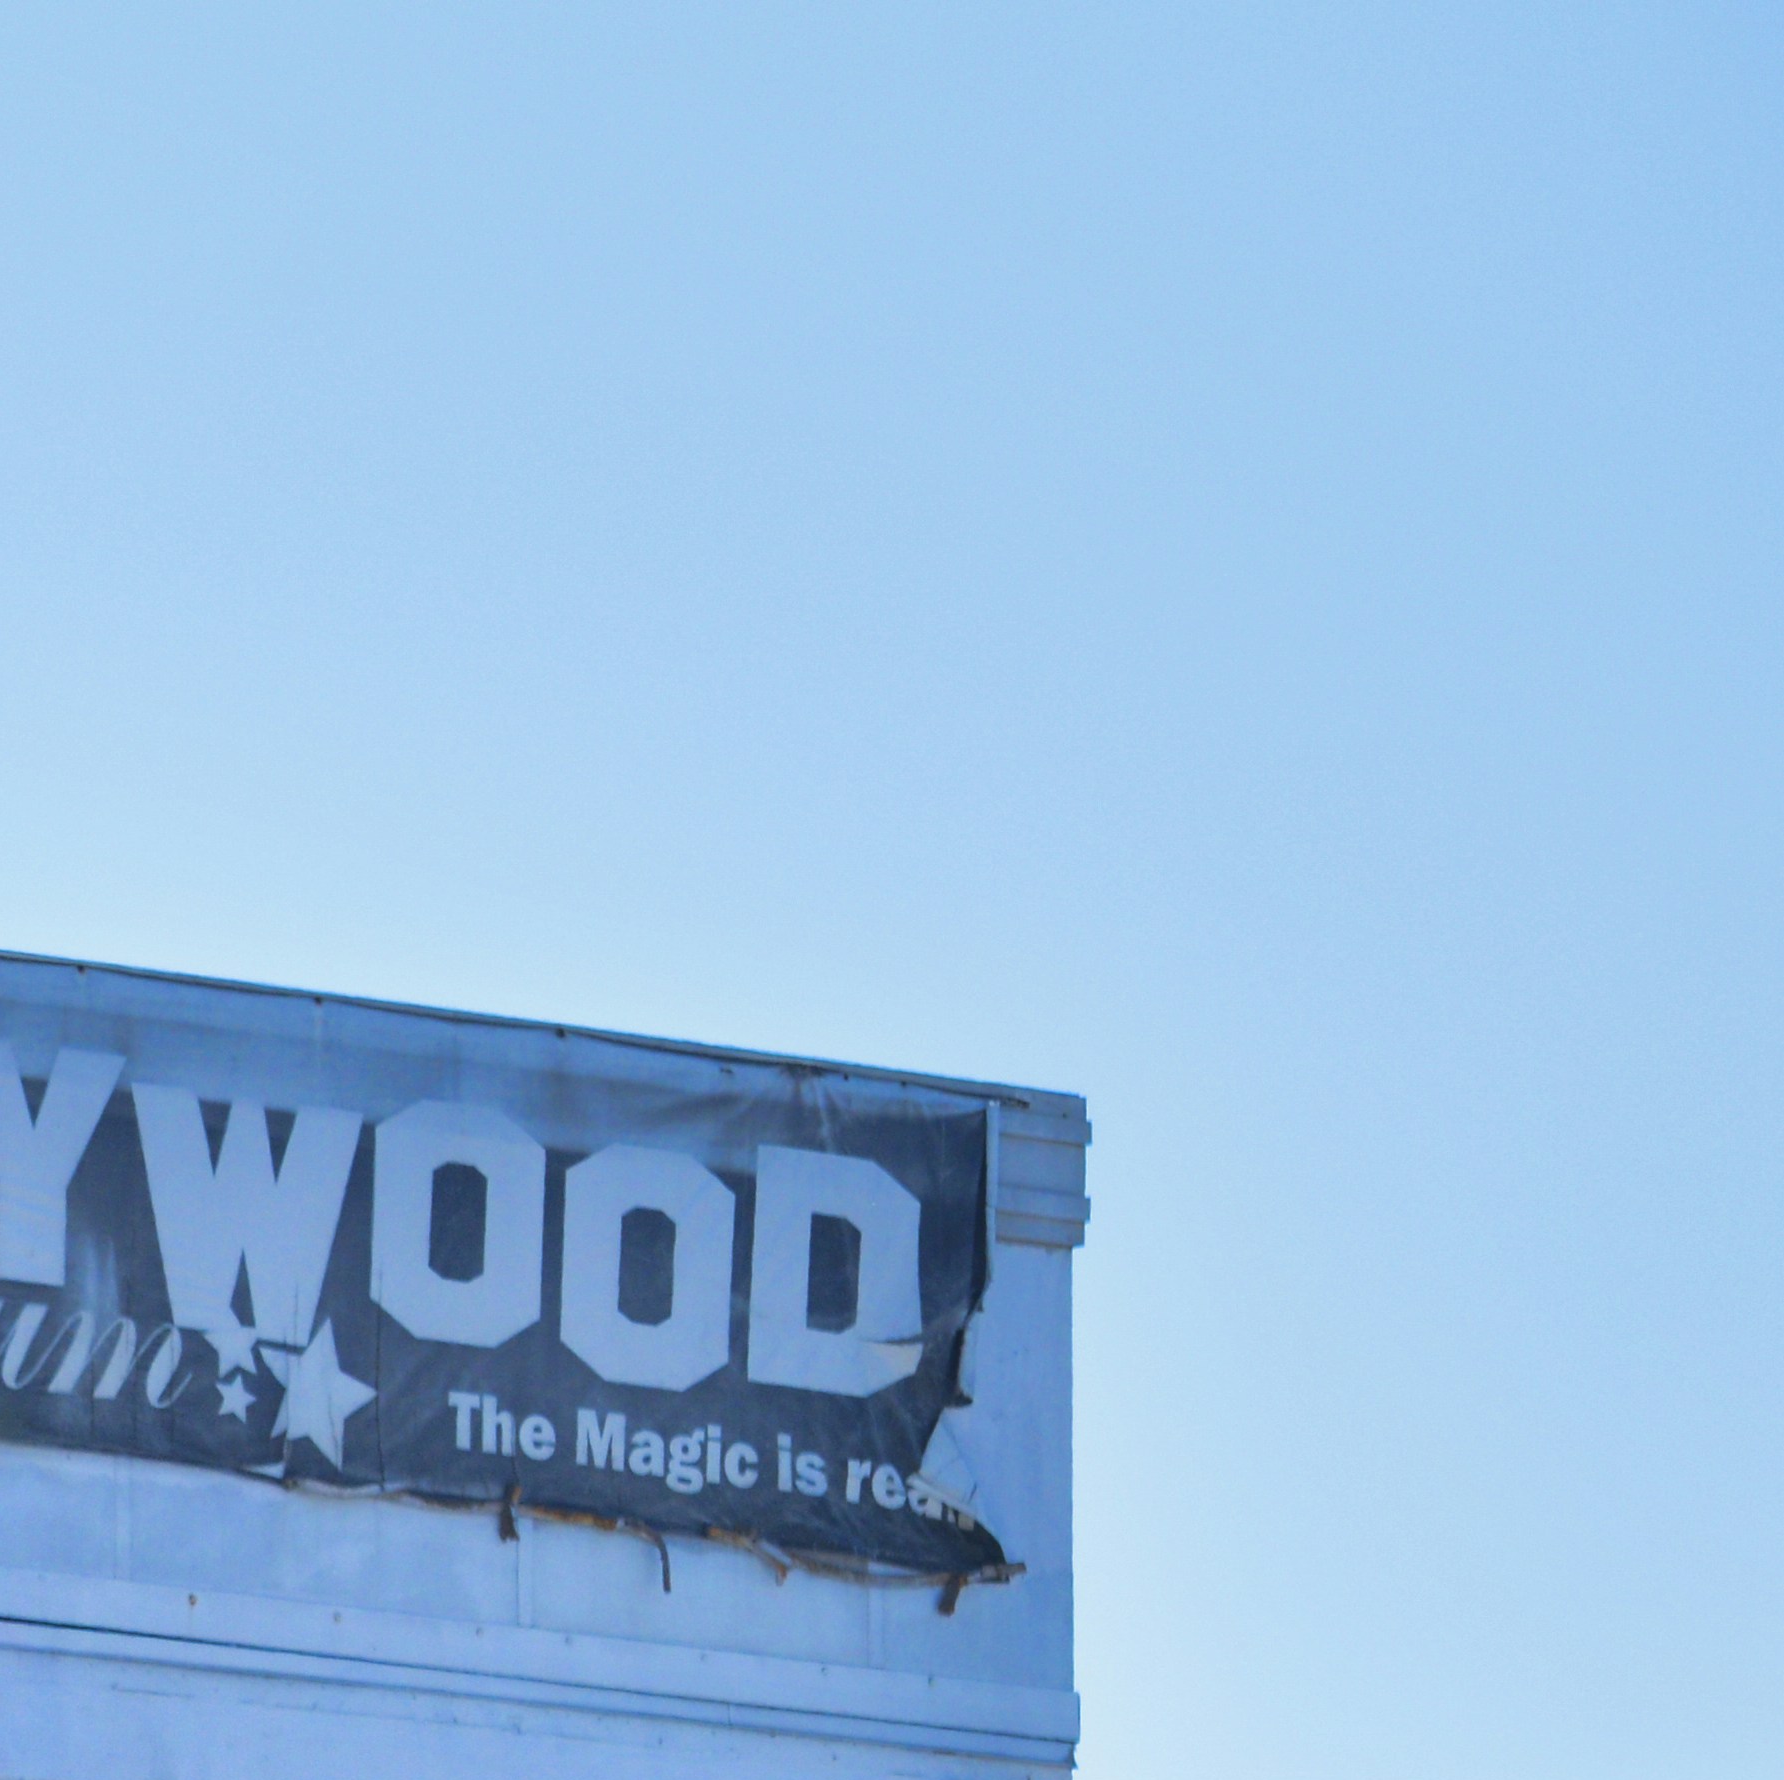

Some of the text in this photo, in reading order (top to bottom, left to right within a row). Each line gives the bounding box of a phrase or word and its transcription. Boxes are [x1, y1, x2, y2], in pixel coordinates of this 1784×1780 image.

[447, 1391, 557, 1462] The
[575, 1406, 759, 1495] Magic
[776, 1432, 829, 1498] is
